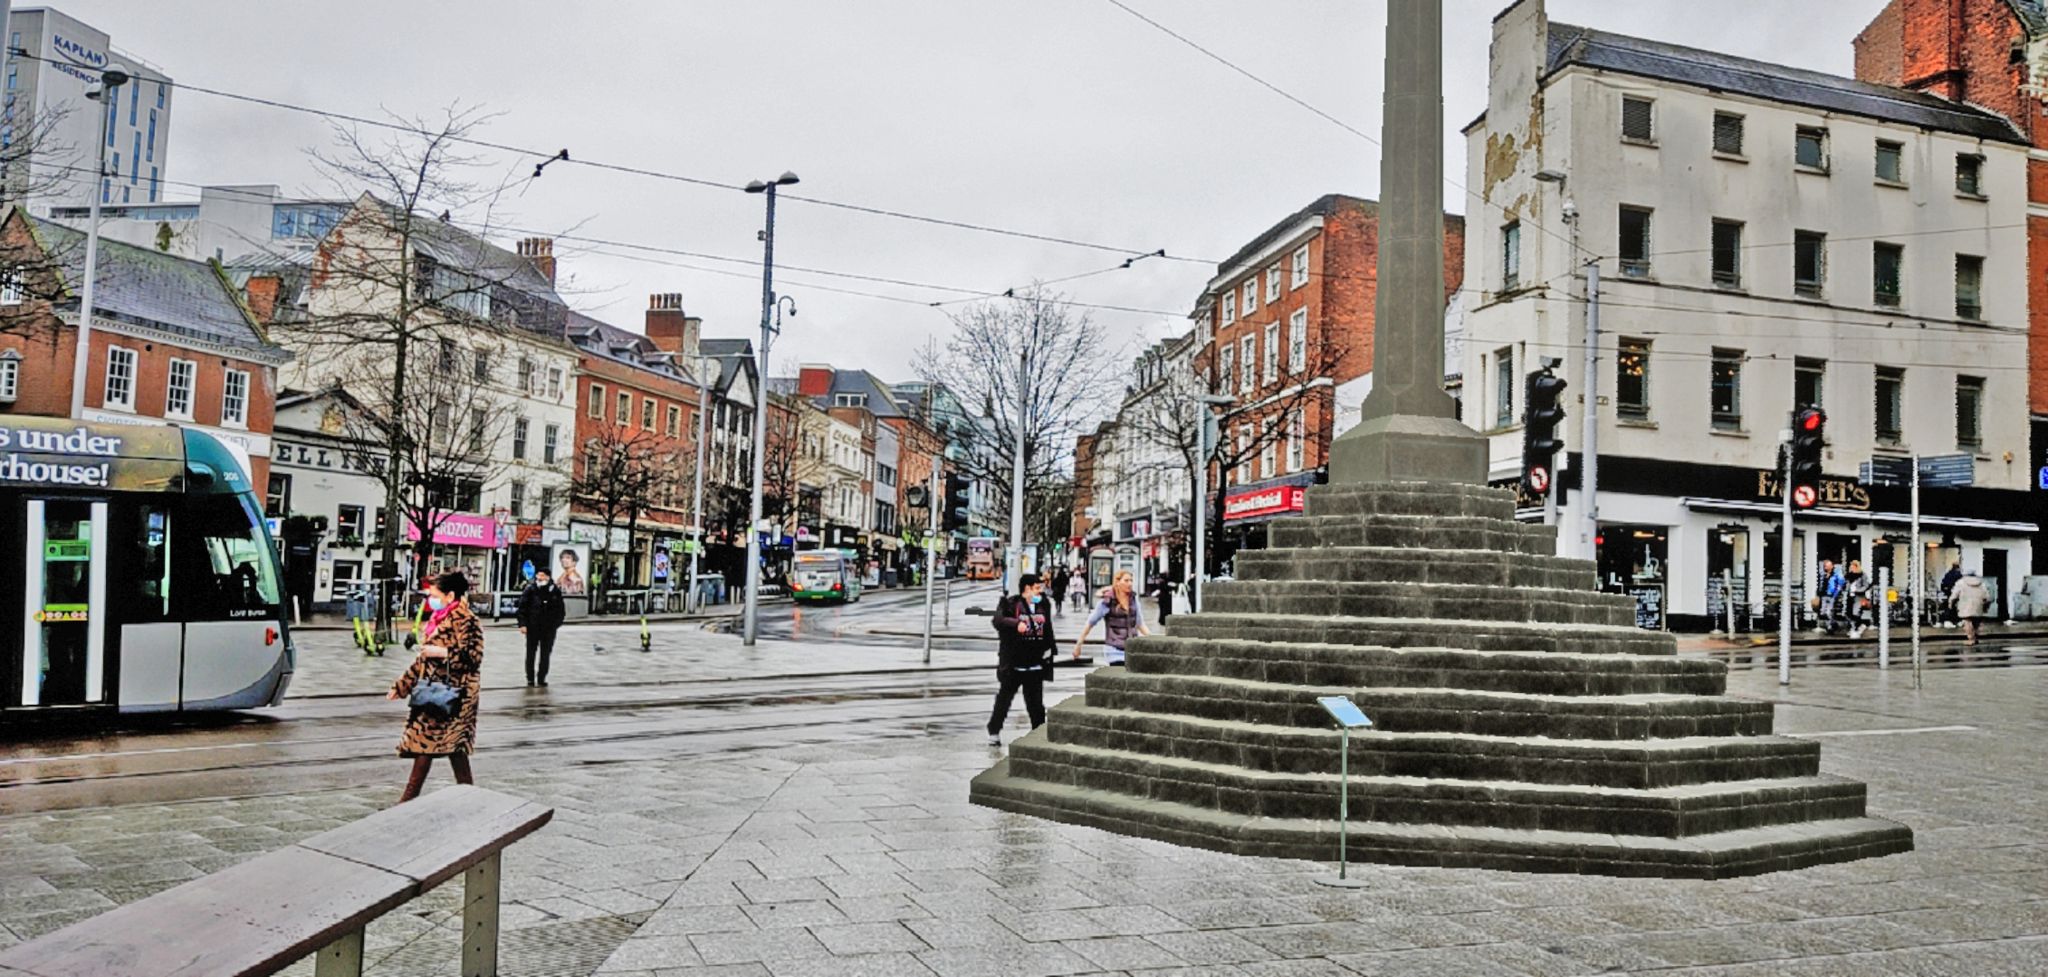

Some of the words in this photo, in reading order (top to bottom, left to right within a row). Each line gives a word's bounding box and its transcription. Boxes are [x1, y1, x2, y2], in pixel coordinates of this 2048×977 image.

[54, 34, 103, 64] KAPLAN
[17, 427, 121, 456] under
[276, 443, 331, 467] ELL
[434, 520, 484, 539] ARDZONE
